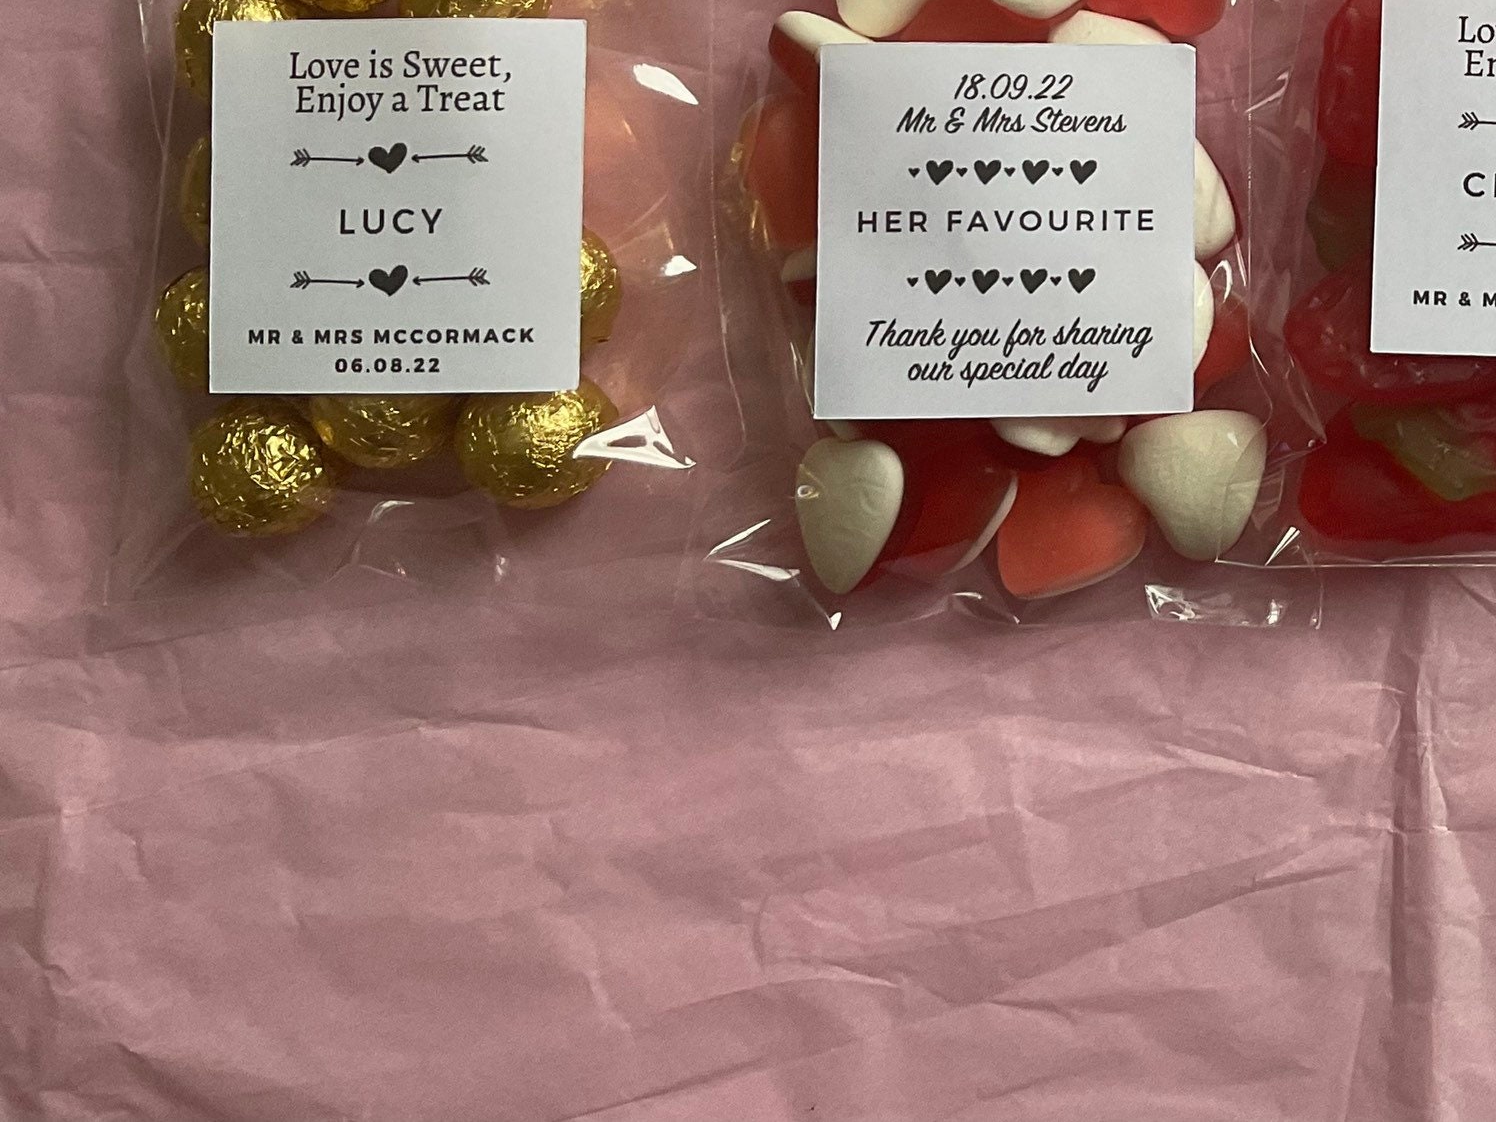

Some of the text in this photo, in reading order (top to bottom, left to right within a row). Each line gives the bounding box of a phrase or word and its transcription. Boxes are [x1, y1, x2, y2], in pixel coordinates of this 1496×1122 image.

[289, 49, 511, 83] Love is Sweet,
[953, 73, 1074, 101] 18.09.22
[295, 82, 506, 122] Enjoy a Treat
[896, 106, 1127, 134] Mr & Mrs Stevens
[339, 208, 443, 235] LUCY
[857, 209, 1154, 234] HER FAVOURITE
[1413, 289, 1447, 306] MR
[1458, 291, 1471, 307] &
[248, 327, 534, 345] MR & MRS MCCORMACK
[865, 316, 1154, 361] Thank you for sharing
[334, 357, 440, 374] 06.08.22
[907, 352, 1109, 393] our special day
